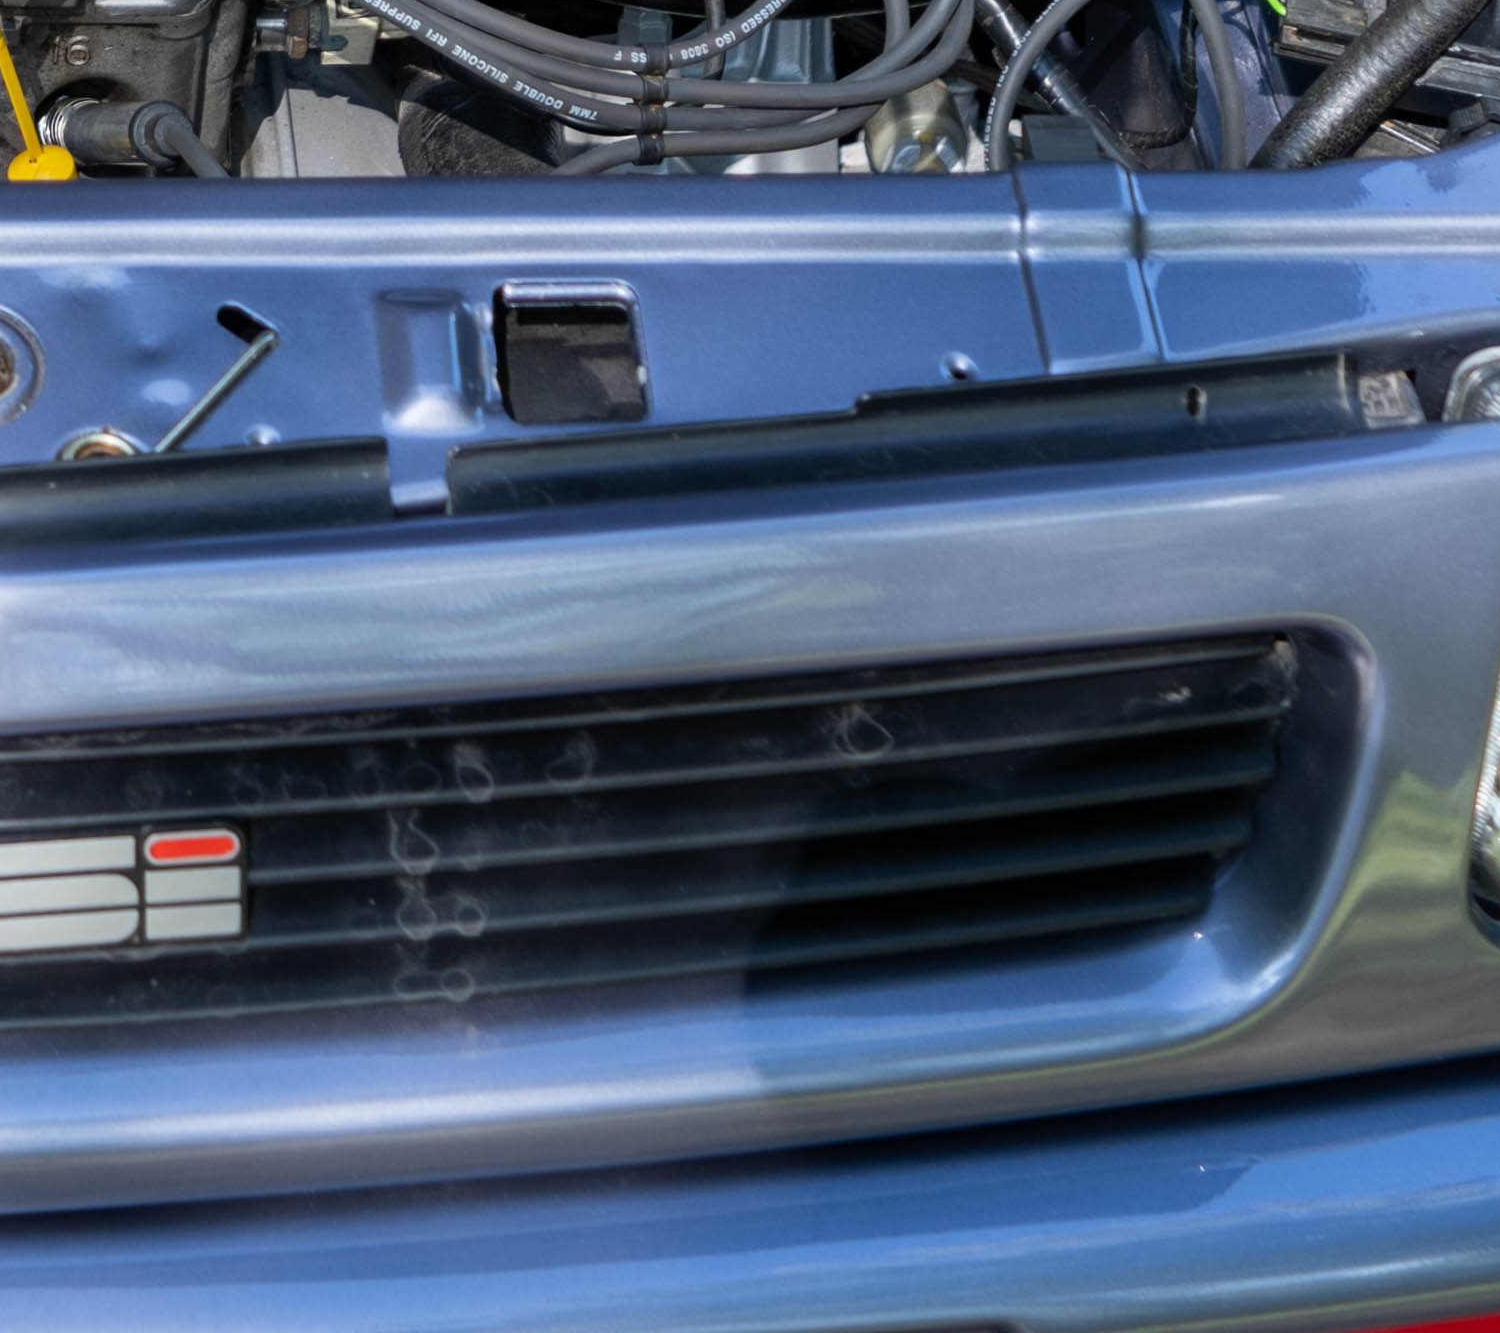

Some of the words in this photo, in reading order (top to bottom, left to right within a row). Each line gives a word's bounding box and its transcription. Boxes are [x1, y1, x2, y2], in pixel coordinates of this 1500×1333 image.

[425, 27, 448, 47] RFI
[715, 29, 737, 49] ISO
[450, 43, 510, 84] SILICONE
[511, 79, 565, 111] DOUBLE
[568, 102, 599, 122] 7MM
